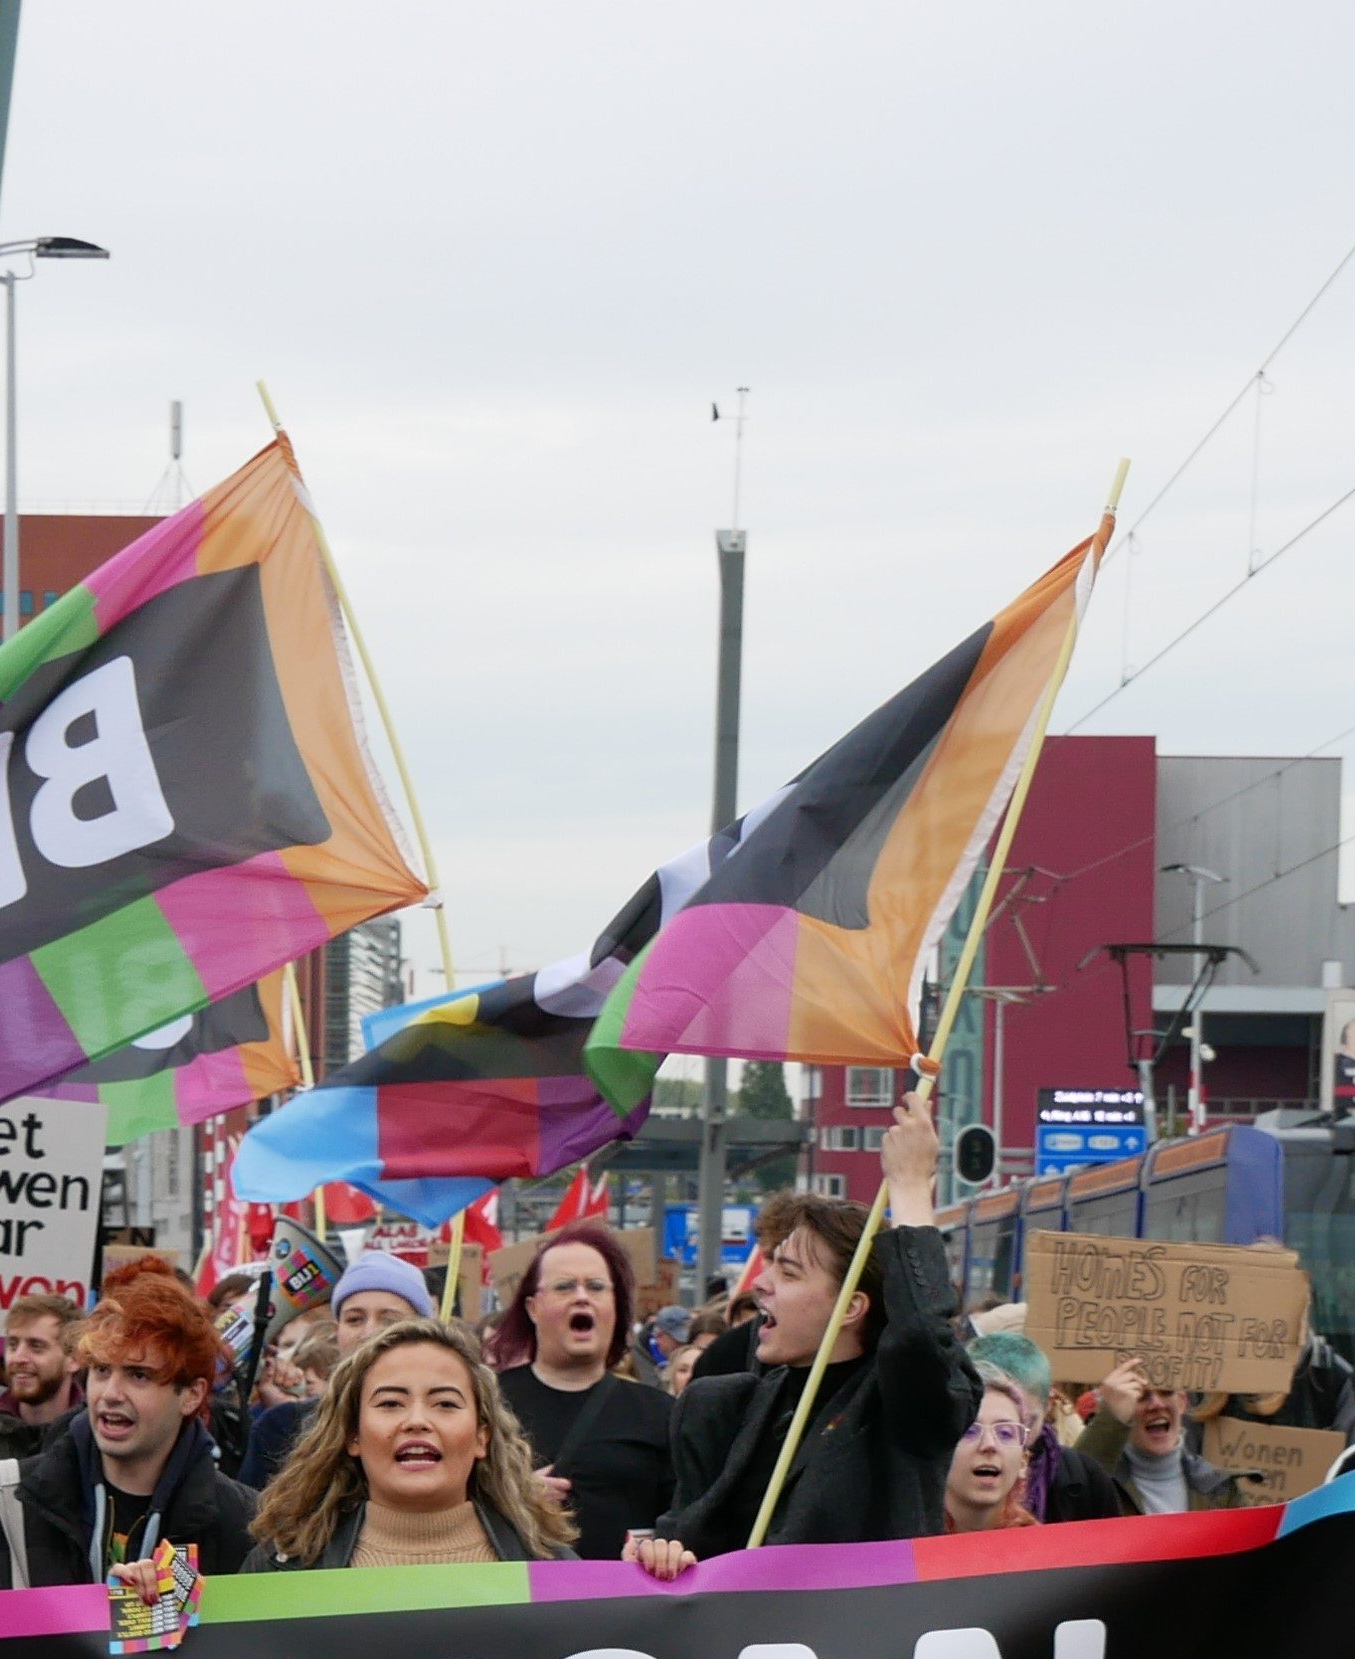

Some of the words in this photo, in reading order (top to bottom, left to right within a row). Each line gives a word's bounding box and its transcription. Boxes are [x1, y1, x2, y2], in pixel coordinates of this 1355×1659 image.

[1179, 1265, 1229, 1305] FOR
[1176, 1312, 1234, 1356] NOT
[1237, 1318, 1287, 1359] FOR
